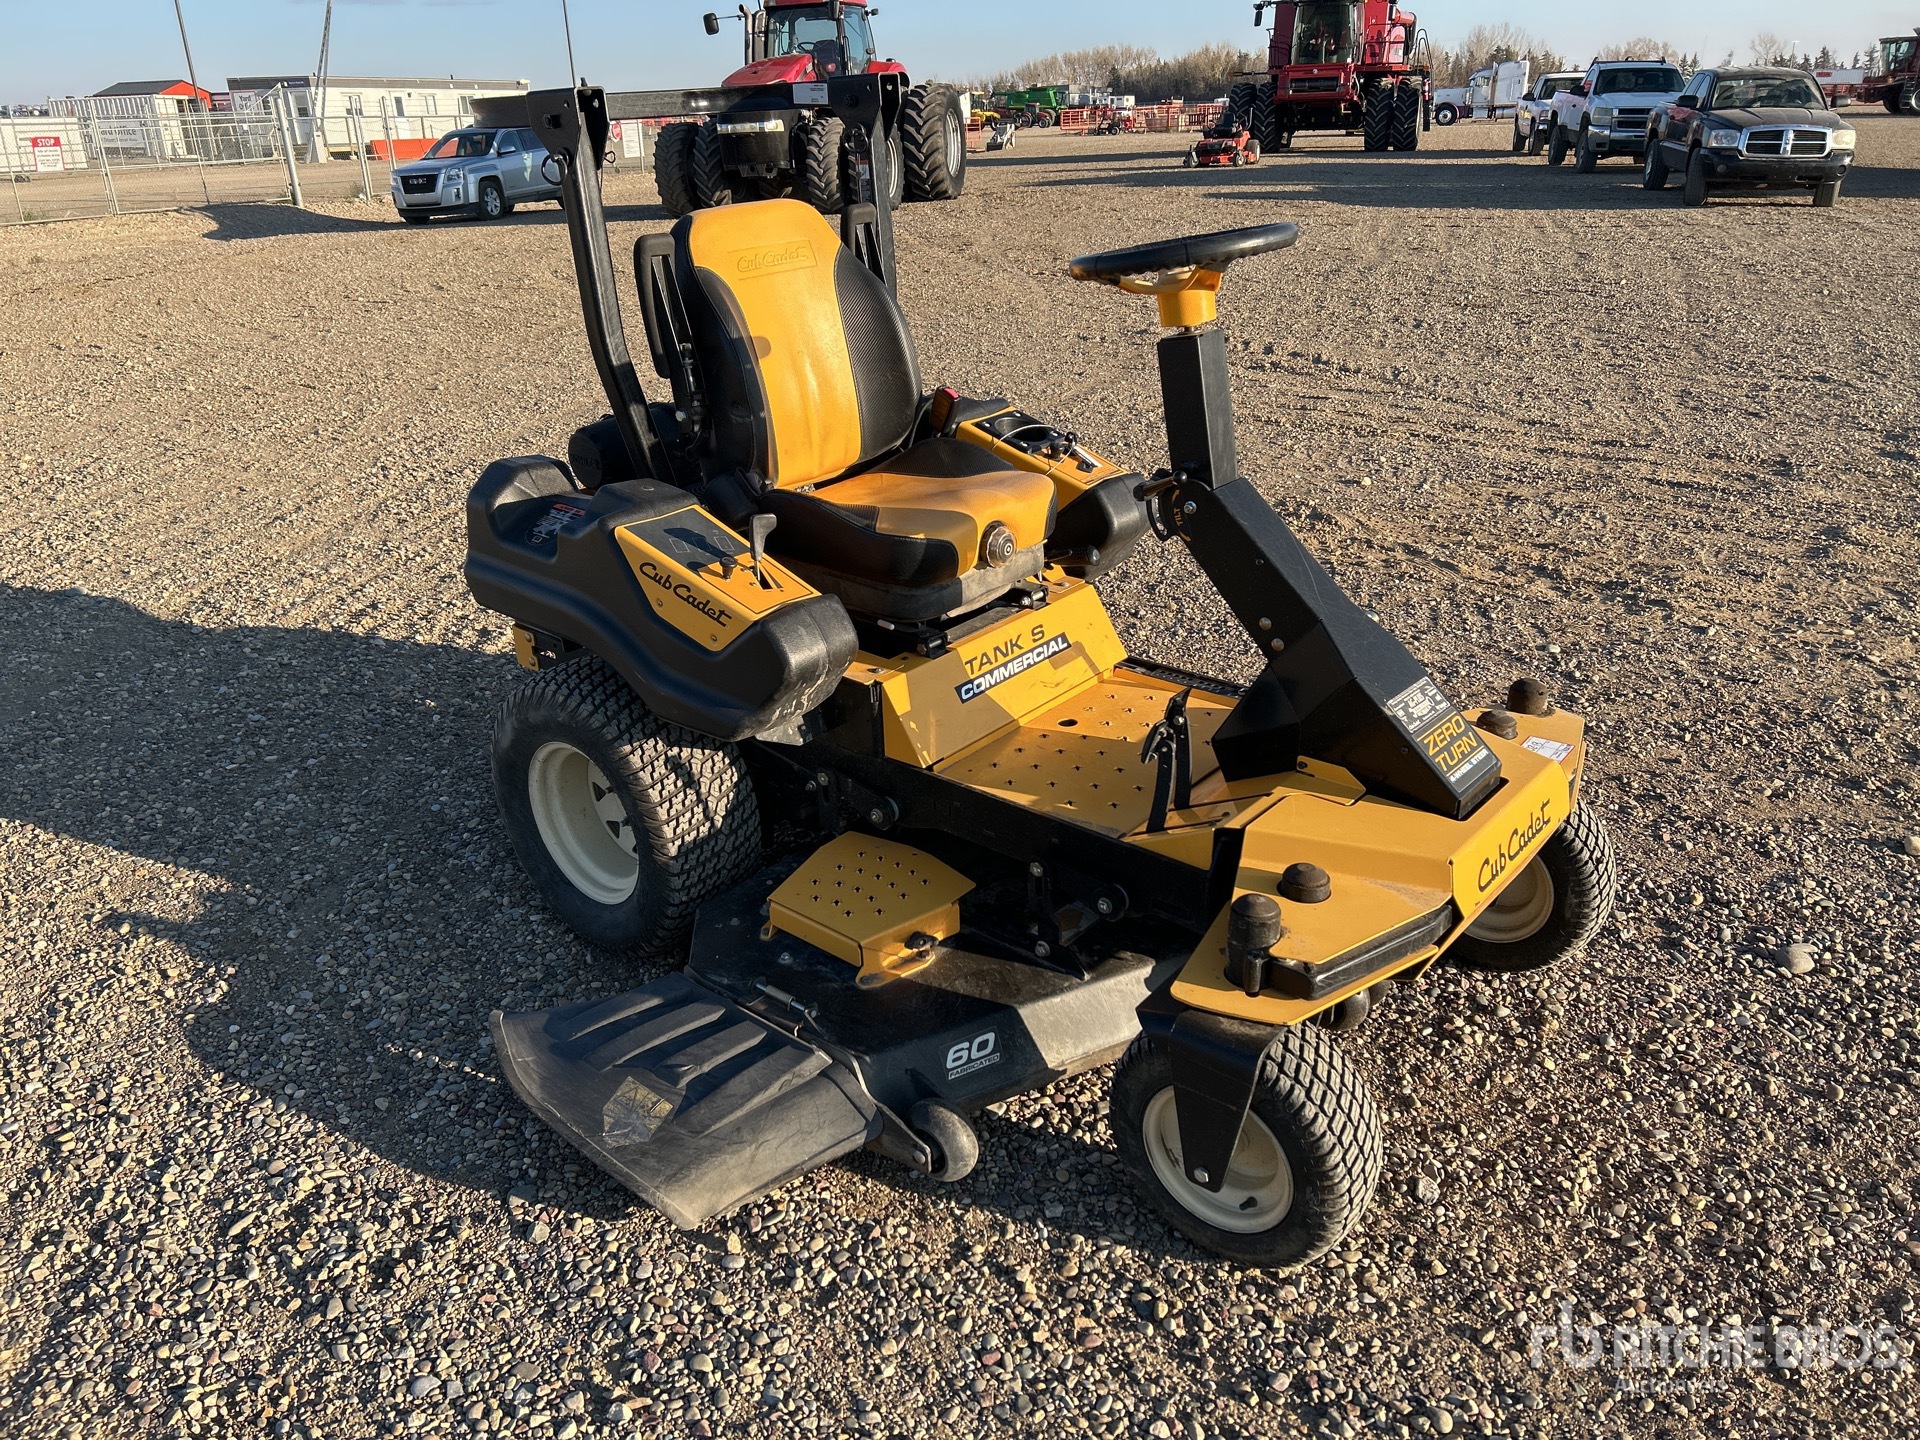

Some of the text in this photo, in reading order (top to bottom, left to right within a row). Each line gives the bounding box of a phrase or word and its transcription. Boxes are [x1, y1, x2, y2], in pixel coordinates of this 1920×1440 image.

[37, 138, 55, 147] STOP
[737, 245, 808, 273] Cub Cadet
[1173, 507, 1184, 527] TILT
[639, 561, 733, 628] Cub Cadet
[960, 636, 1069, 701] COMMERCIAL
[964, 623, 1045, 676] TANK S
[1423, 715, 1466, 756] ZERO
[1434, 731, 1478, 772] TURN
[1478, 798, 1552, 893] Cub Cadet
[946, 1031, 996, 1069] 60
[949, 1054, 999, 1079] FABRICATED
